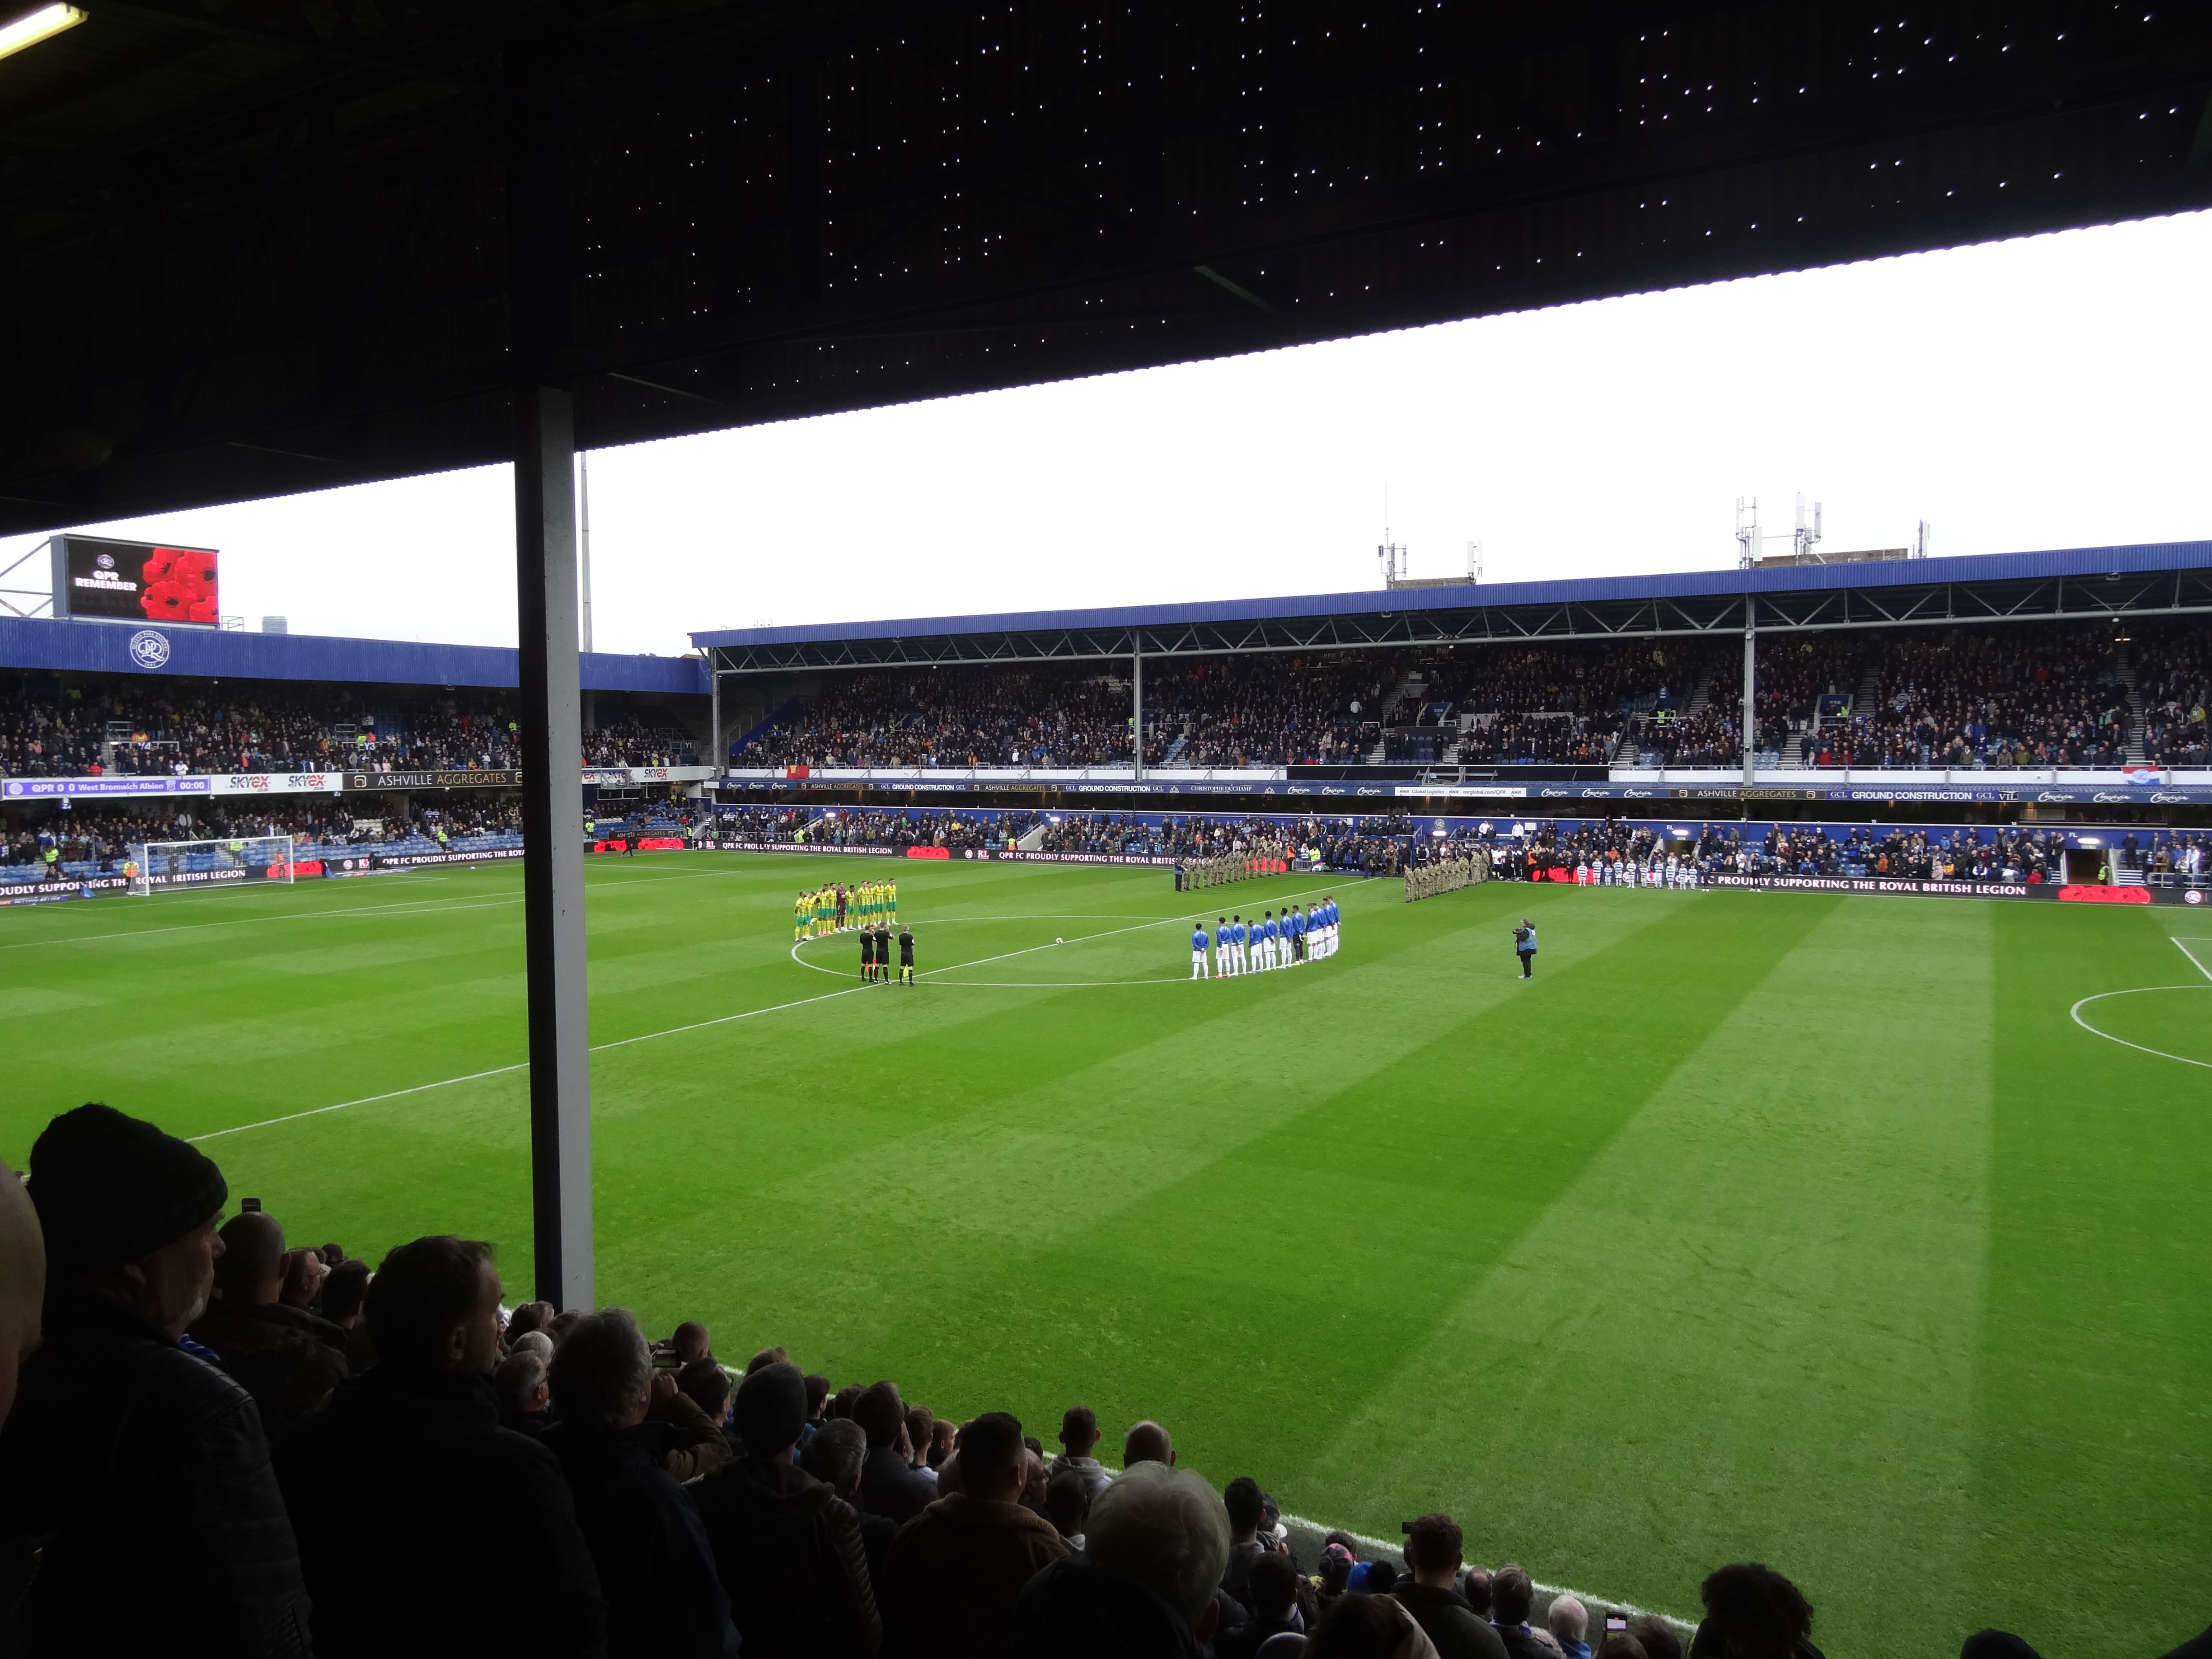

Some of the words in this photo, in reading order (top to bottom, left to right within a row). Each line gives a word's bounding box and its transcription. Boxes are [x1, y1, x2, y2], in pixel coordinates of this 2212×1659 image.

[93, 570, 119, 581] QPR
[75, 577, 137, 591] REMEMBER
[364, 742, 375, 750] Y3
[378, 775, 432, 787] ASHVILLE
[437, 773, 506, 784] AGGREGATES
[32, 784, 54, 792] QPR
[57, 784, 64, 792] 0
[100, 782, 137, 790] Bromwich
[1541, 788, 1569, 797] Convivia
[1582, 788, 1610, 798] Convivia
[1624, 789, 1653, 798] Convivia
[1895, 792, 1972, 800] CONSTRUCTION
[2038, 792, 2075, 802] Convivia
[2093, 792, 2131, 802] Convivia
[2150, 792, 2189, 803] Convivia
[772, 844, 809, 852] SUPPORTING
[412, 856, 446, 864] PROUDLY
[448, 853, 493, 862] SUPPORTING
[508, 849, 525, 858] ROYA
[999, 852, 1014, 860] QPR
[1026, 853, 1059, 861] PROUDLY
[1060, 853, 1106, 862] SUPPORTING
[1126, 855, 1150, 863] ROYAL
[1152, 857, 1178, 865] BRITIS
[39, 878, 109, 892] SUPPOING
[112, 878, 129, 886] TH
[211, 870, 245, 879] LEGION
[1718, 876, 1771, 886] PROUDLY
[1774, 878, 1849, 890] SUPPORTING
[1853, 881, 1875, 890] THE
[1879, 881, 1918, 891] ROYAL
[1922, 883, 1971, 893] BRITISH
[1976, 884, 2026, 895] LEGION
